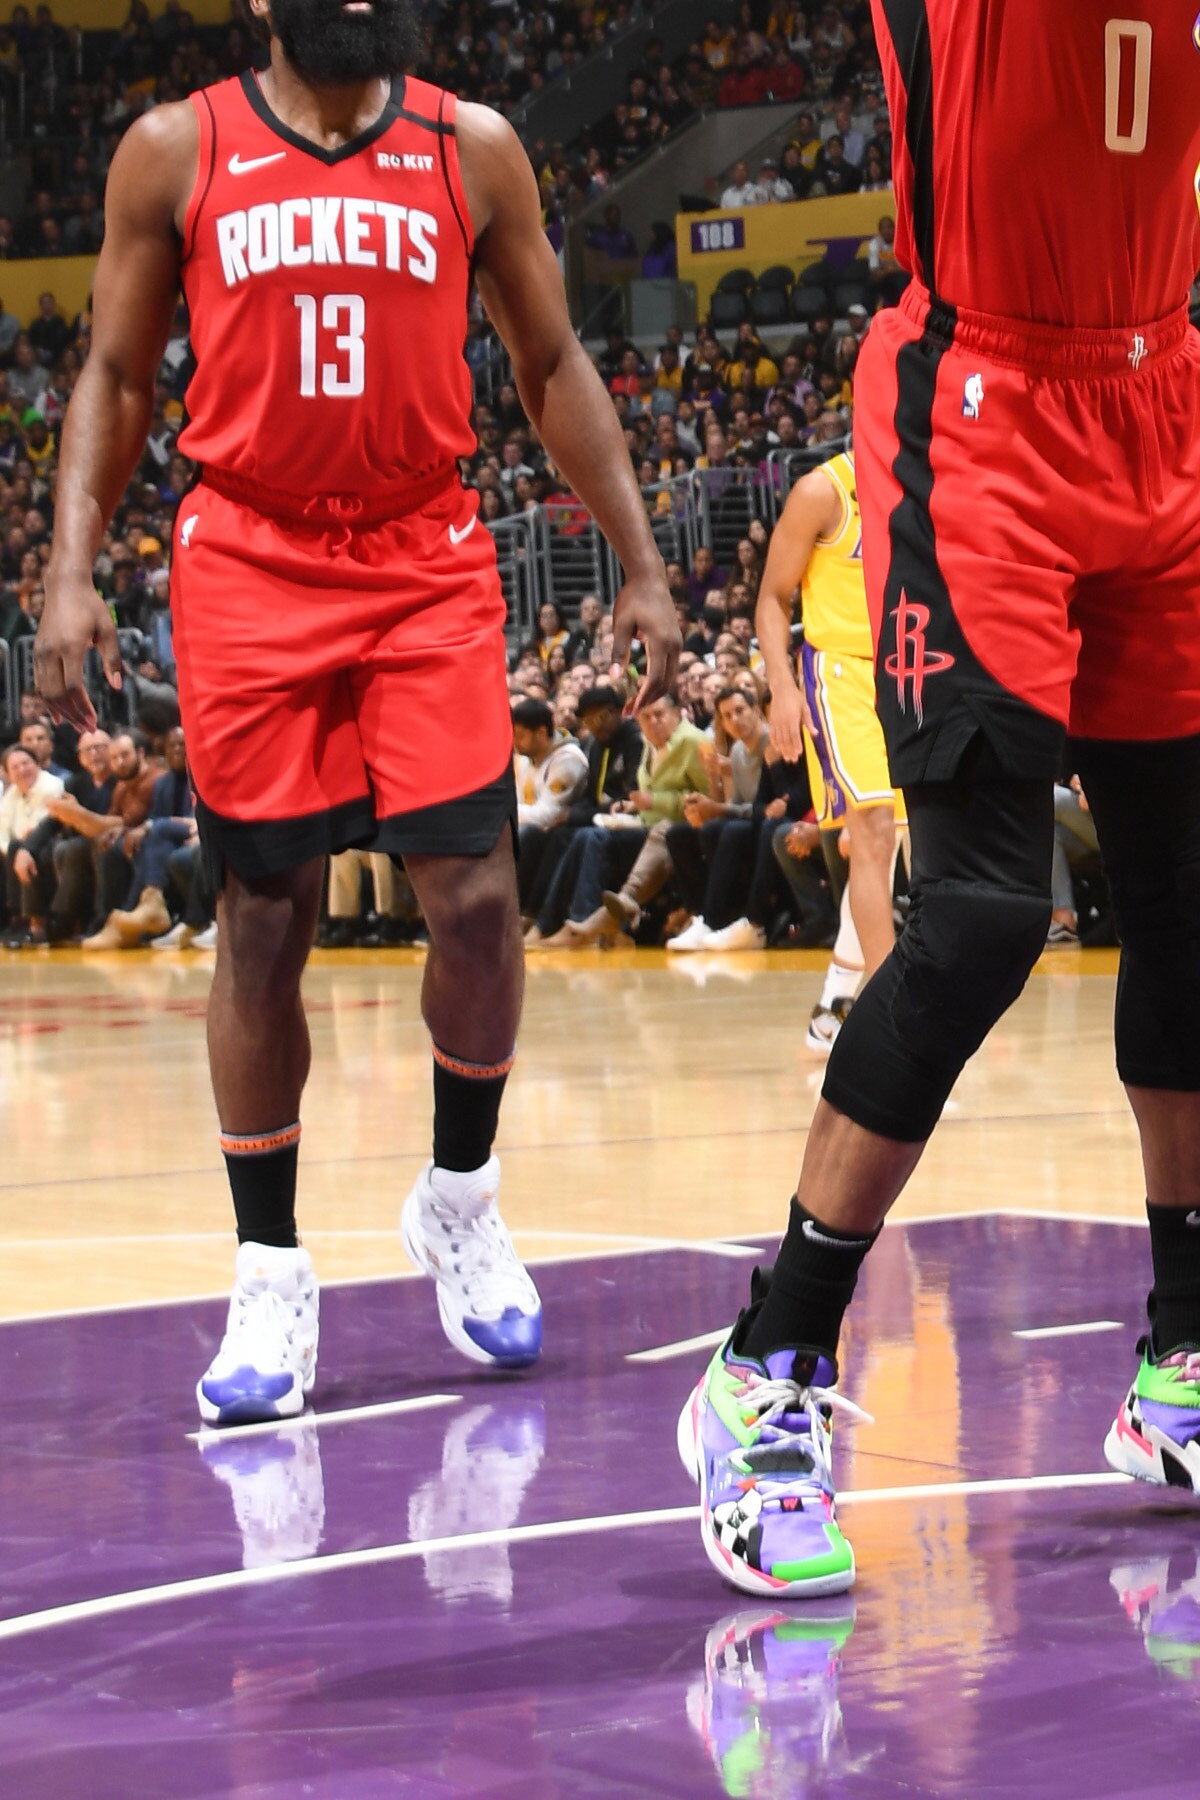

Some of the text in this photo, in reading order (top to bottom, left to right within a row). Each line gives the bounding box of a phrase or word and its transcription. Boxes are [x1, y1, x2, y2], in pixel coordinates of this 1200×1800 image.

[1105, 18, 1153, 155] 0
[216, 197, 438, 288] ROCKETS
[294, 294, 366, 398] 13
